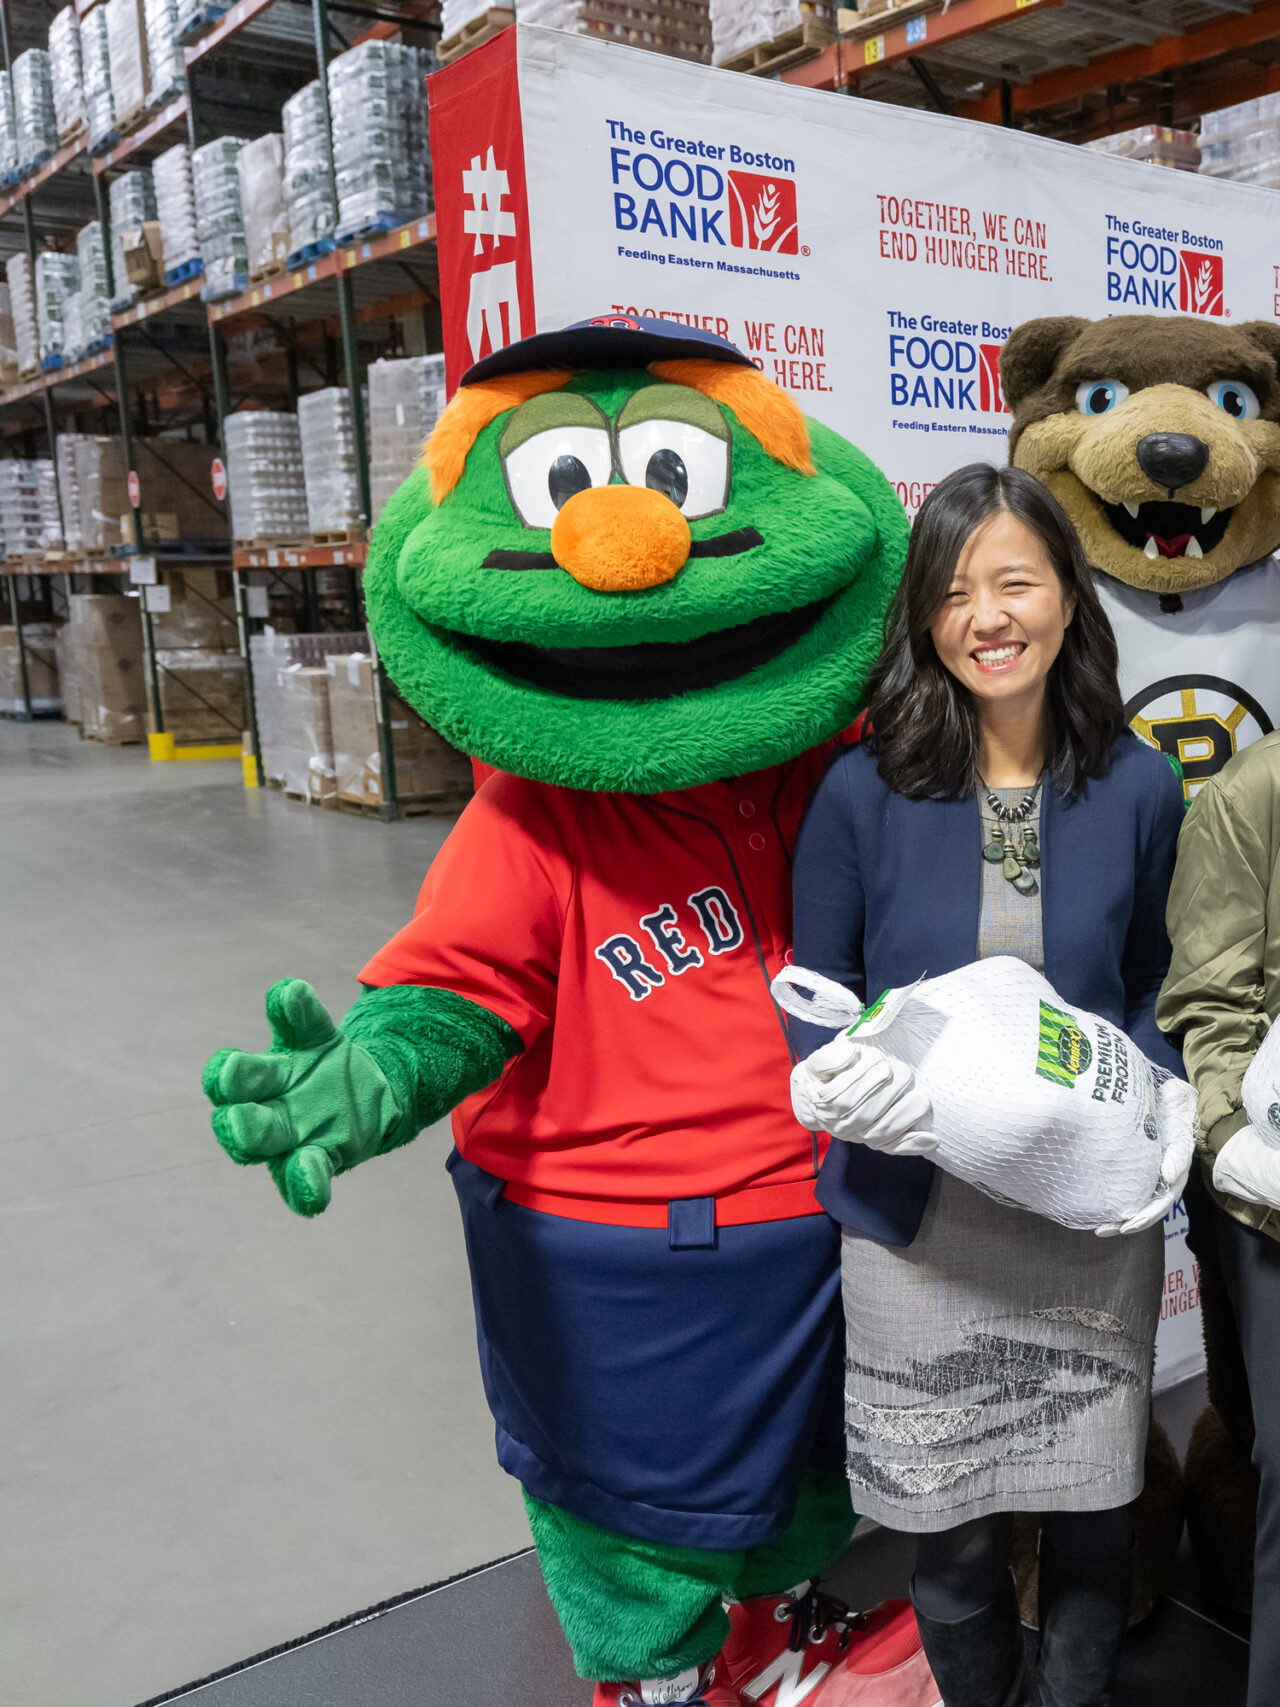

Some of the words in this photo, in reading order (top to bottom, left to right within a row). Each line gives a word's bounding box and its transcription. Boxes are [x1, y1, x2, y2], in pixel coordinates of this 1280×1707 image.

[606, 119, 645, 145] The
[650, 130, 725, 160] Greater
[730, 145, 795, 173] Boston
[610, 147, 724, 201] FOOD
[614, 192, 726, 246] BANK
[877, 195, 976, 241] TOGETHER,
[983, 211, 1008, 242] WE
[1014, 218, 1046, 249] CAN
[1105, 214, 1129, 233] The
[1133, 221, 1179, 242] Greater
[1182, 230, 1223, 251] Boston
[618, 247, 666, 264] Feeding
[669, 254, 714, 269] Eastern
[717, 261, 800, 280] Massachusetts
[879, 230, 917, 261] END
[925, 236, 998, 273] HUNGER
[1005, 248, 1053, 282] HERE.
[1107, 236, 1177, 275] FOOD
[1107, 271, 1177, 311] BANK
[744, 321, 777, 352] WE
[784, 325, 824, 357] CAN
[887, 311, 917, 329] The
[921, 315, 978, 336] Greater
[981, 322, 1013, 339] Bost
[889, 334, 976, 373] FOOD
[773, 359, 833, 392] HERE.
[891, 374, 977, 411] BANK
[892, 420, 929, 432] Feeding
[931, 423, 966, 433] Eastern
[969, 425, 1009, 436] Massach
[595, 885, 744, 1001] RED
[1091, 1023, 1112, 1102] PREMIUM
[1111, 1033, 1129, 1105] FROZEN
